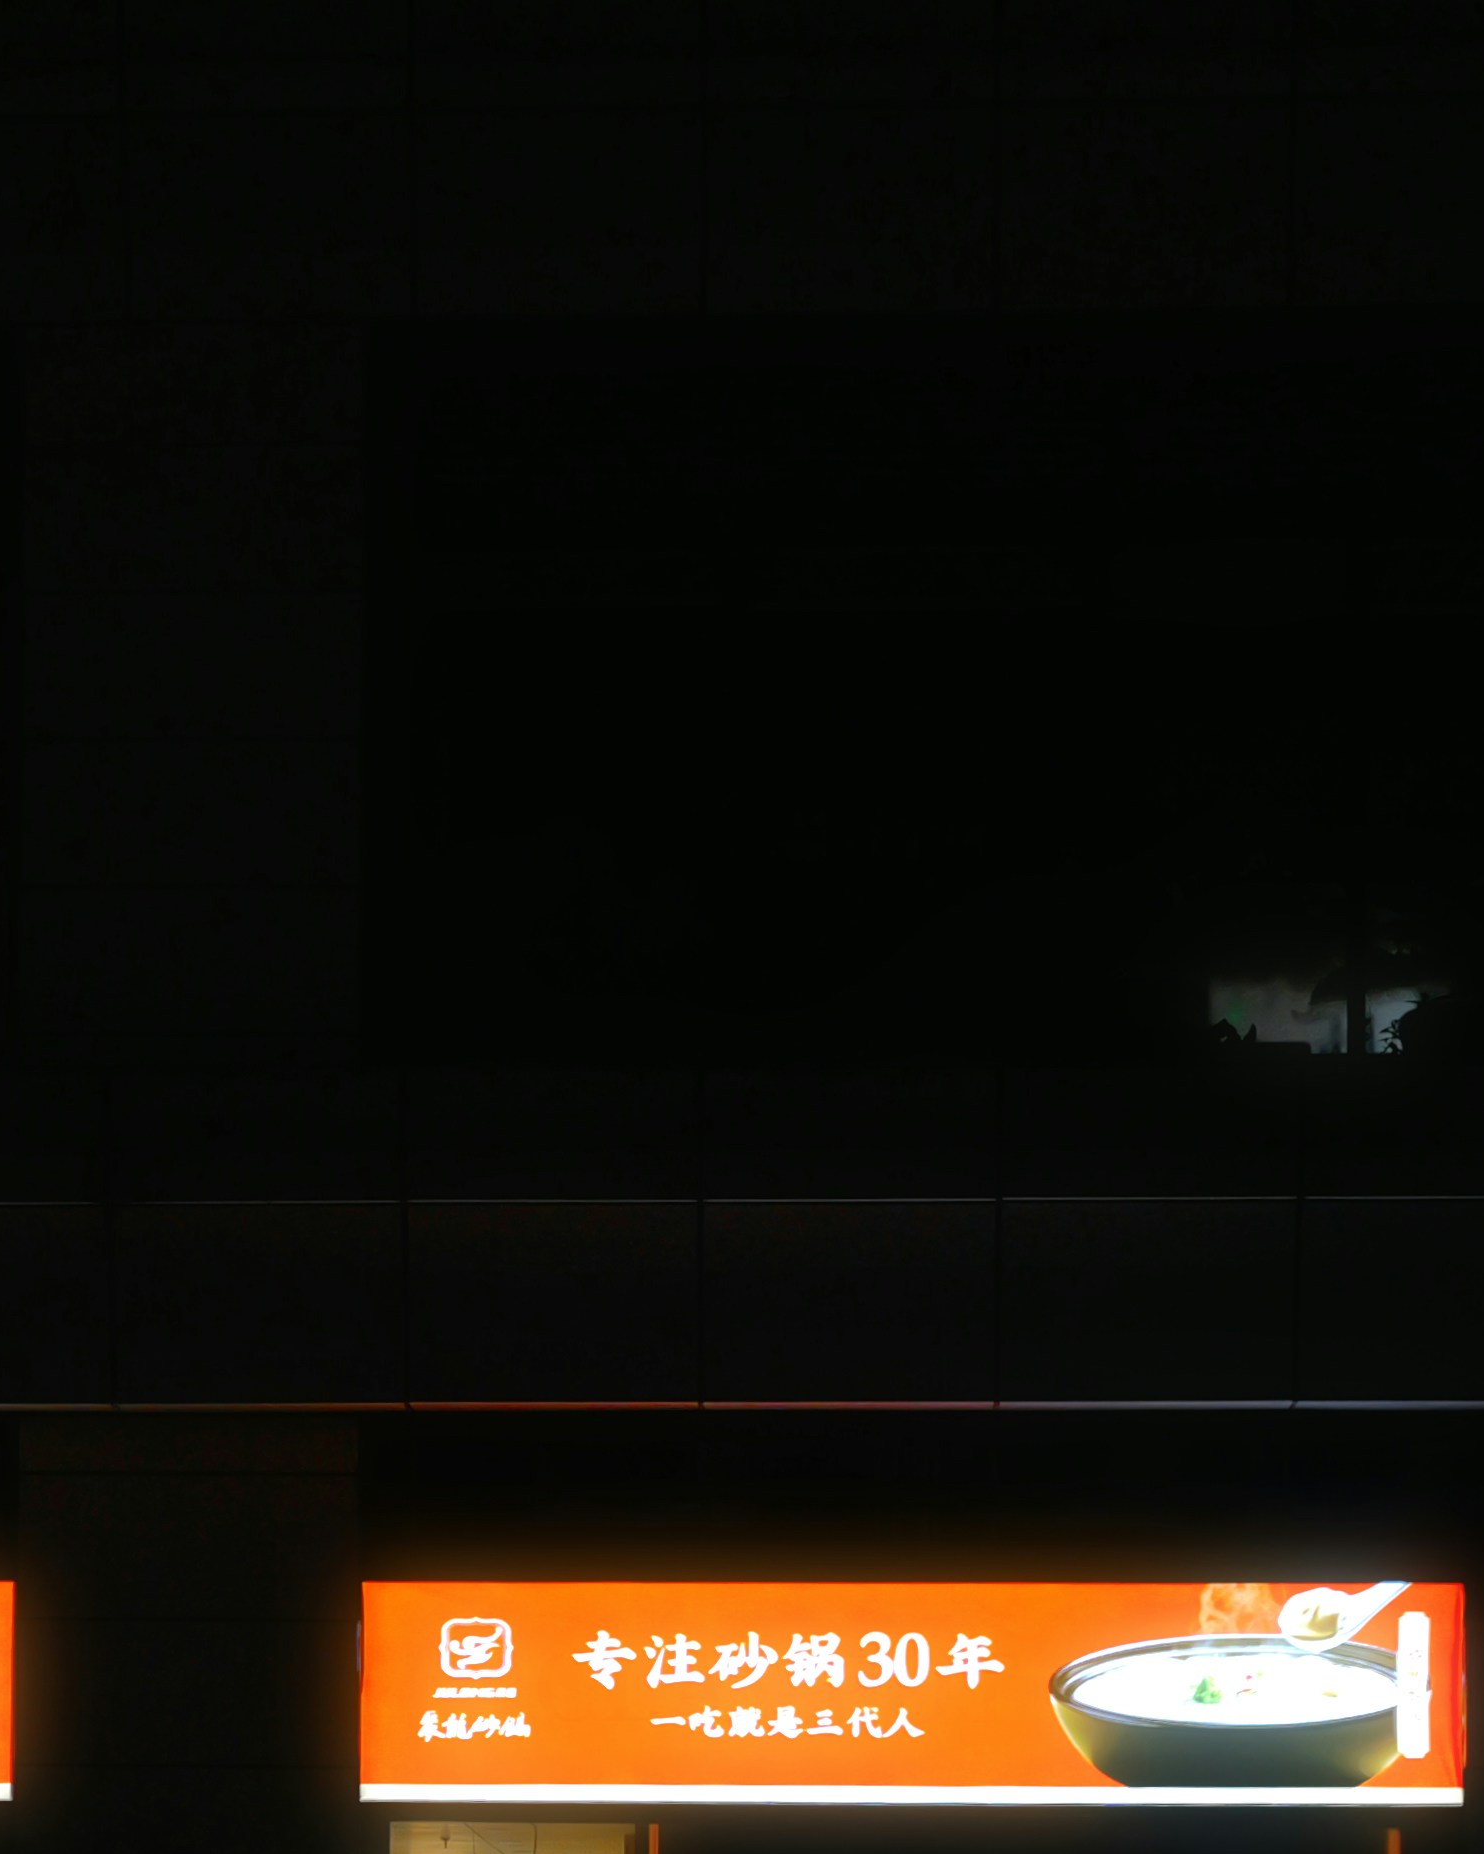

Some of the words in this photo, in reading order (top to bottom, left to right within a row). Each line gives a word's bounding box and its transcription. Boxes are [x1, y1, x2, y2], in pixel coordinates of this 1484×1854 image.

[572, 1629, 1005, 1691] 专注砂锅30年
[650, 1705, 925, 1739] 一吃就是三代人
